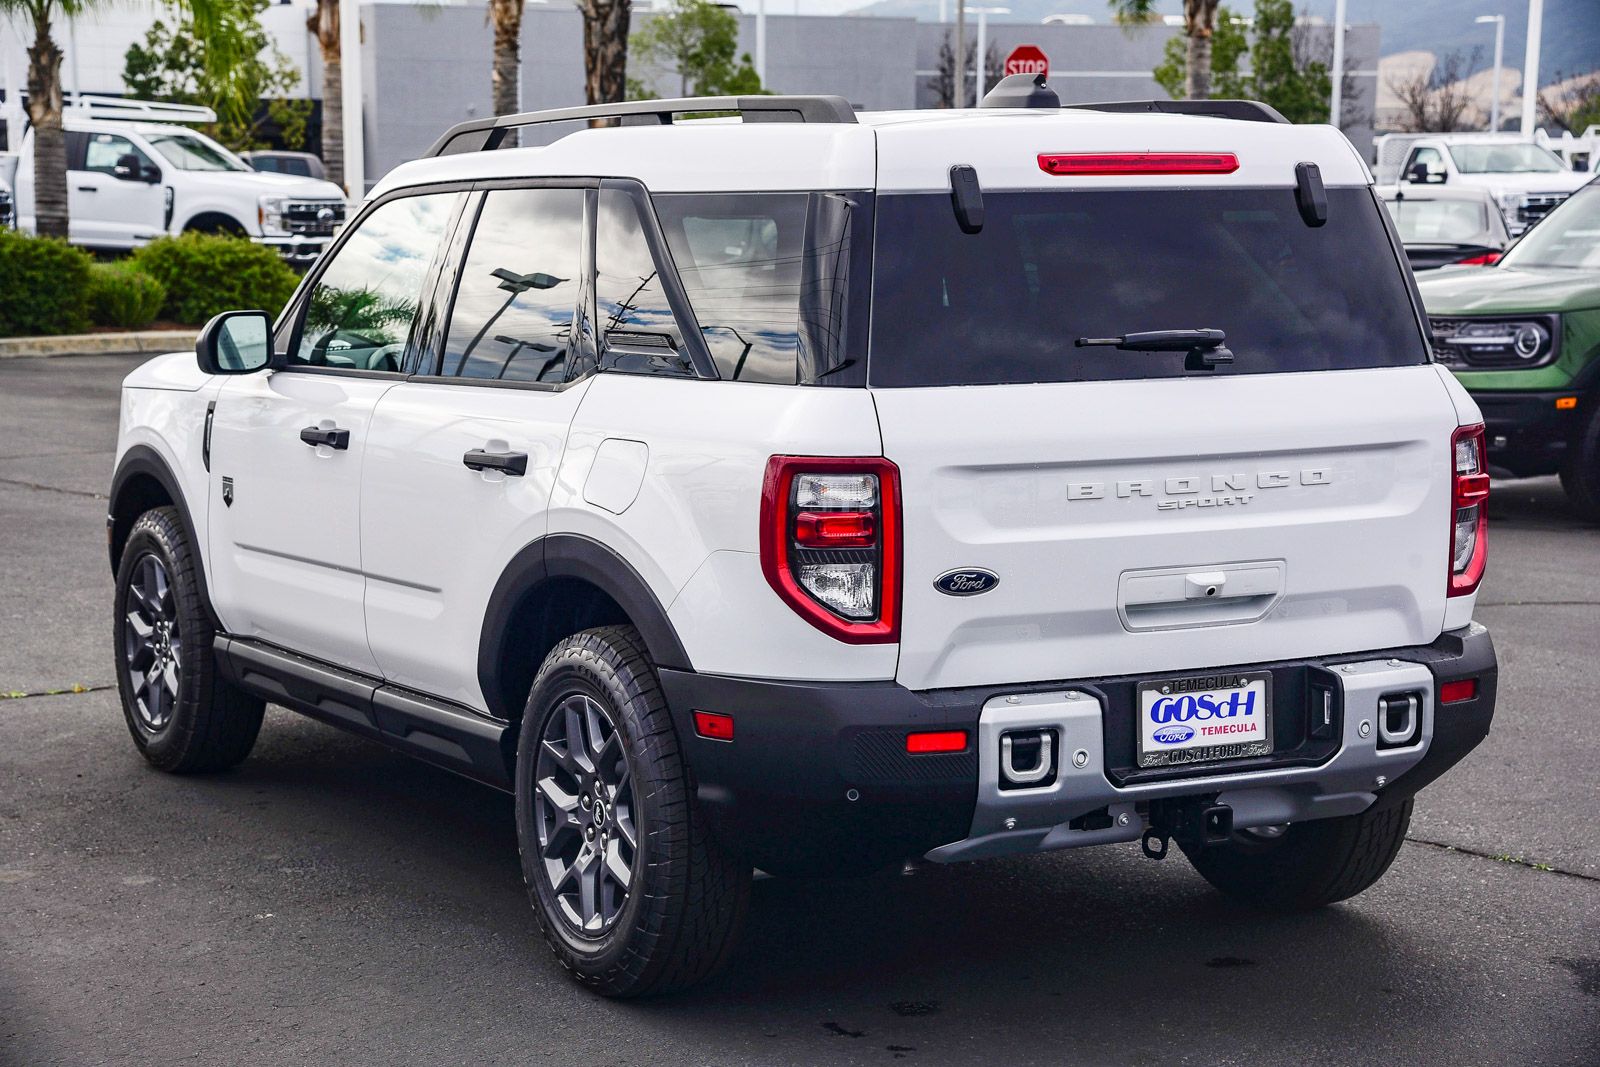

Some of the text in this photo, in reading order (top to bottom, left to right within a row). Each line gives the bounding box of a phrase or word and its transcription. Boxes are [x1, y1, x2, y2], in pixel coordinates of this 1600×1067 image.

[1008, 60, 1046, 74] STOP
[1067, 467, 1332, 500] BRONCO
[1157, 495, 1254, 510] SPORT
[950, 573, 986, 590] Ford
[1171, 675, 1240, 692] TEMECULA
[1158, 729, 1188, 742] Ford
[1201, 722, 1257, 736] TEMECULA
[1212, 744, 1243, 759] FORD
